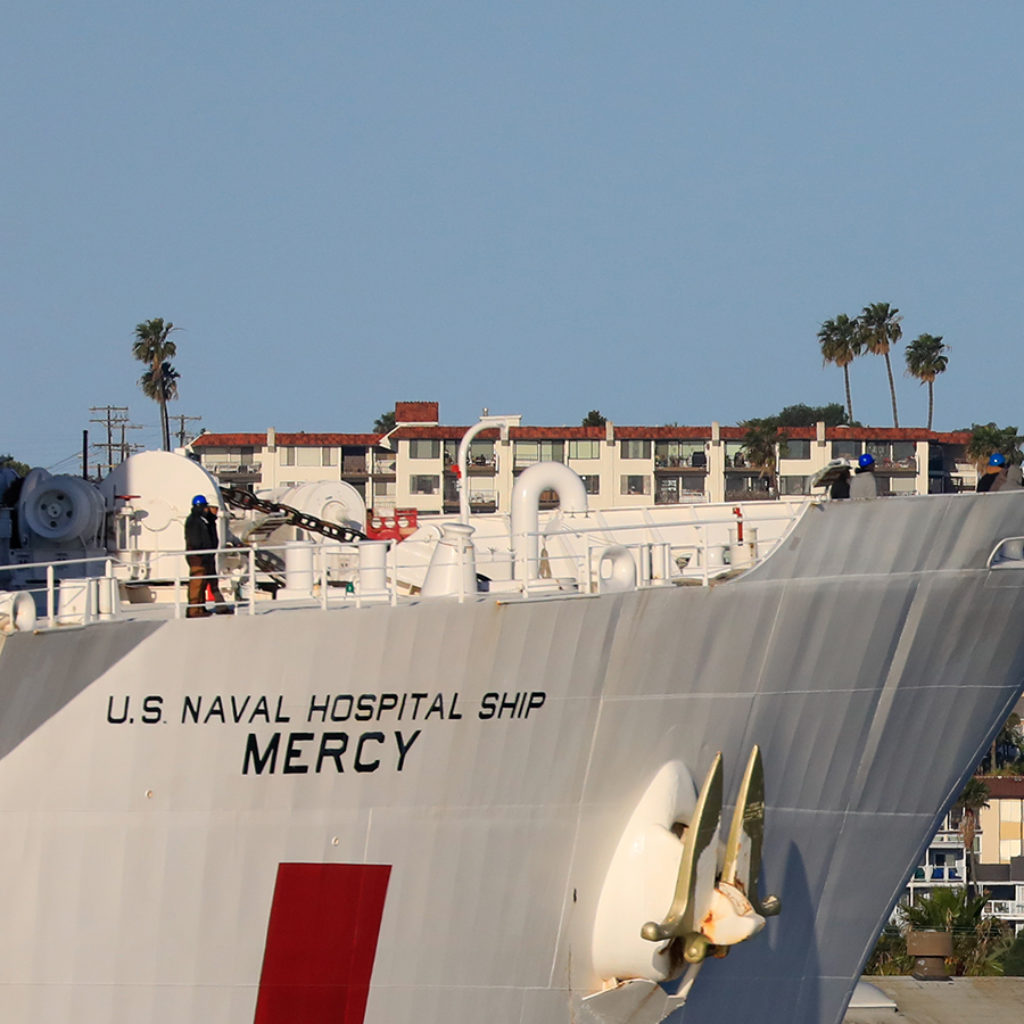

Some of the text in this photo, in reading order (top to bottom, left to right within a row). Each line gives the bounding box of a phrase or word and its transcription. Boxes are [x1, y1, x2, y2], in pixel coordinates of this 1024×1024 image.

[106, 692, 547, 725] U.S. NAVAL HOSPITAL SHIP
[241, 729, 422, 775] MERCY
